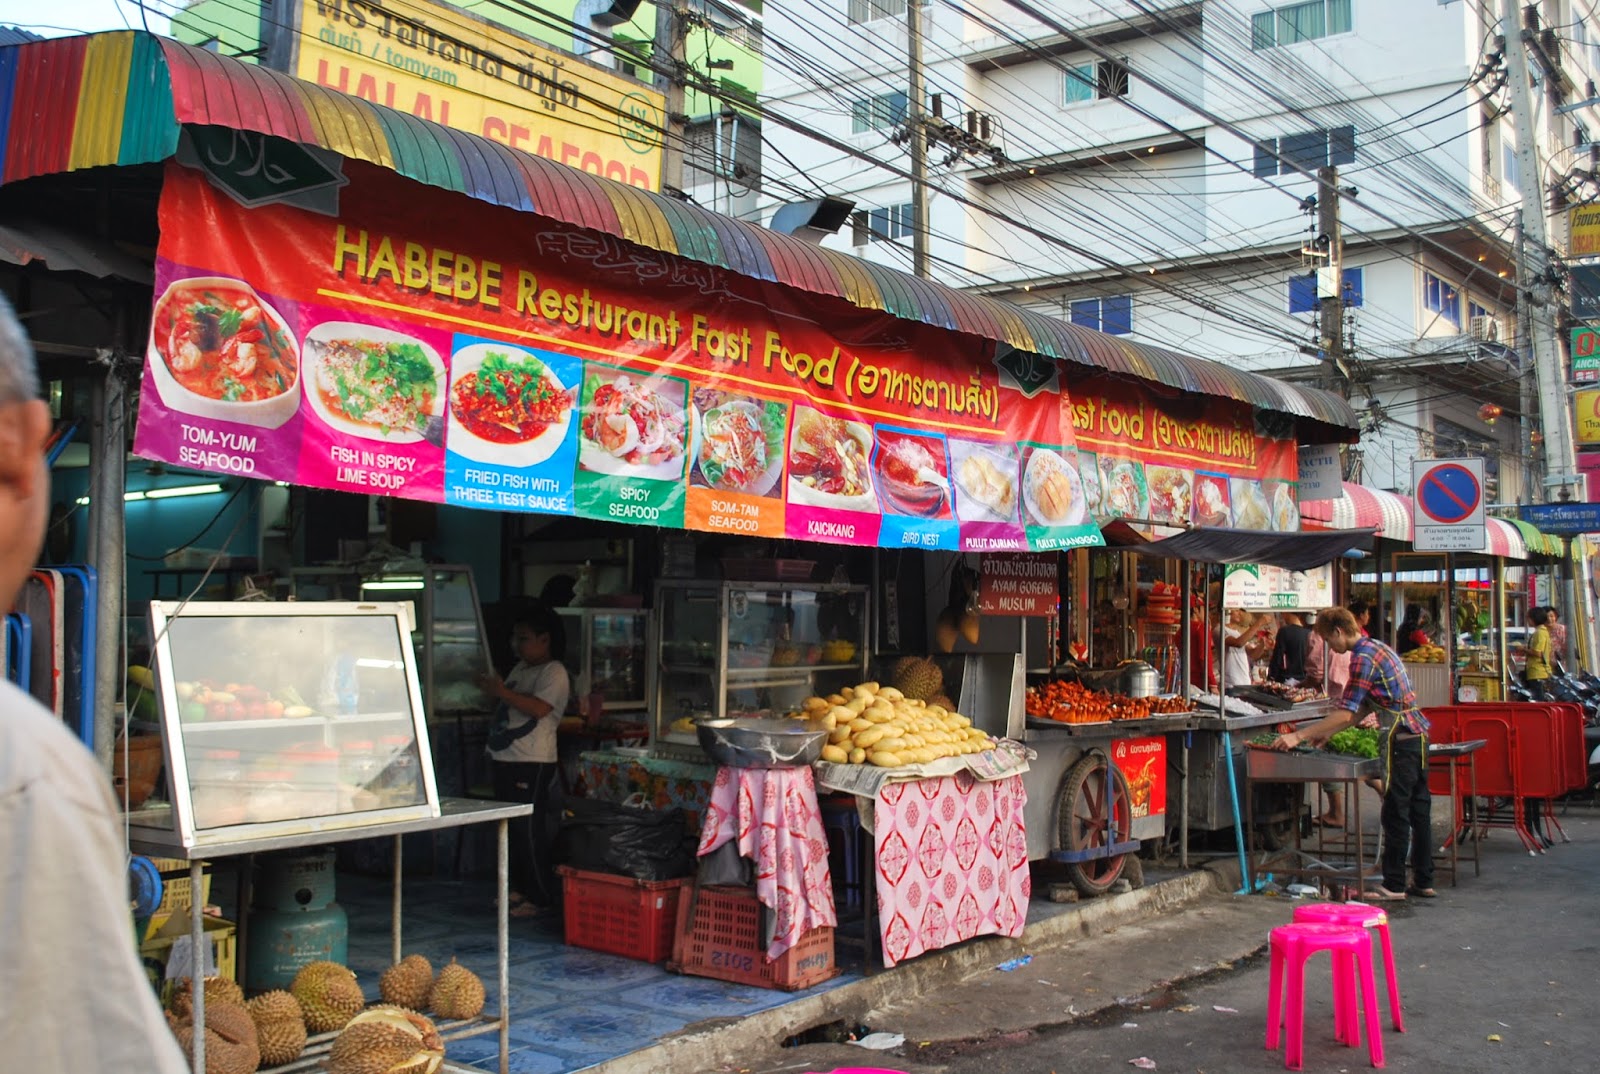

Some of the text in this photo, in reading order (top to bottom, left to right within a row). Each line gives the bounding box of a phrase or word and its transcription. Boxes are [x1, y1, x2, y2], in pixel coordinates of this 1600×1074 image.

[386, 48, 458, 86] tomyam
[334, 224, 840, 386] HABEBE Resturant Fast Food
[180, 424, 257, 453] TOM-YUM
[179, 447, 255, 473] SEAFOOD
[331, 446, 416, 473] FISH IN SPICY
[336, 468, 405, 490] LIME SOUP
[465, 468, 560, 493] FRIED FISH WITH
[453, 485, 567, 512] THREE TEST SAUCE
[620, 487, 650, 502] SPICY
[608, 503, 659, 520] SEAFOOD
[711, 500, 759, 518] SOM-TAM
[708, 515, 759, 532] SEAFOOD
[807, 520, 855, 539] KAICIKANG
[901, 531, 940, 546] BIRD NEST
[965, 537, 1019, 549] PULUT DURIAN
[992, 580, 1053, 595] AYAM GORENG
[999, 597, 1036, 611] MUSLIM
